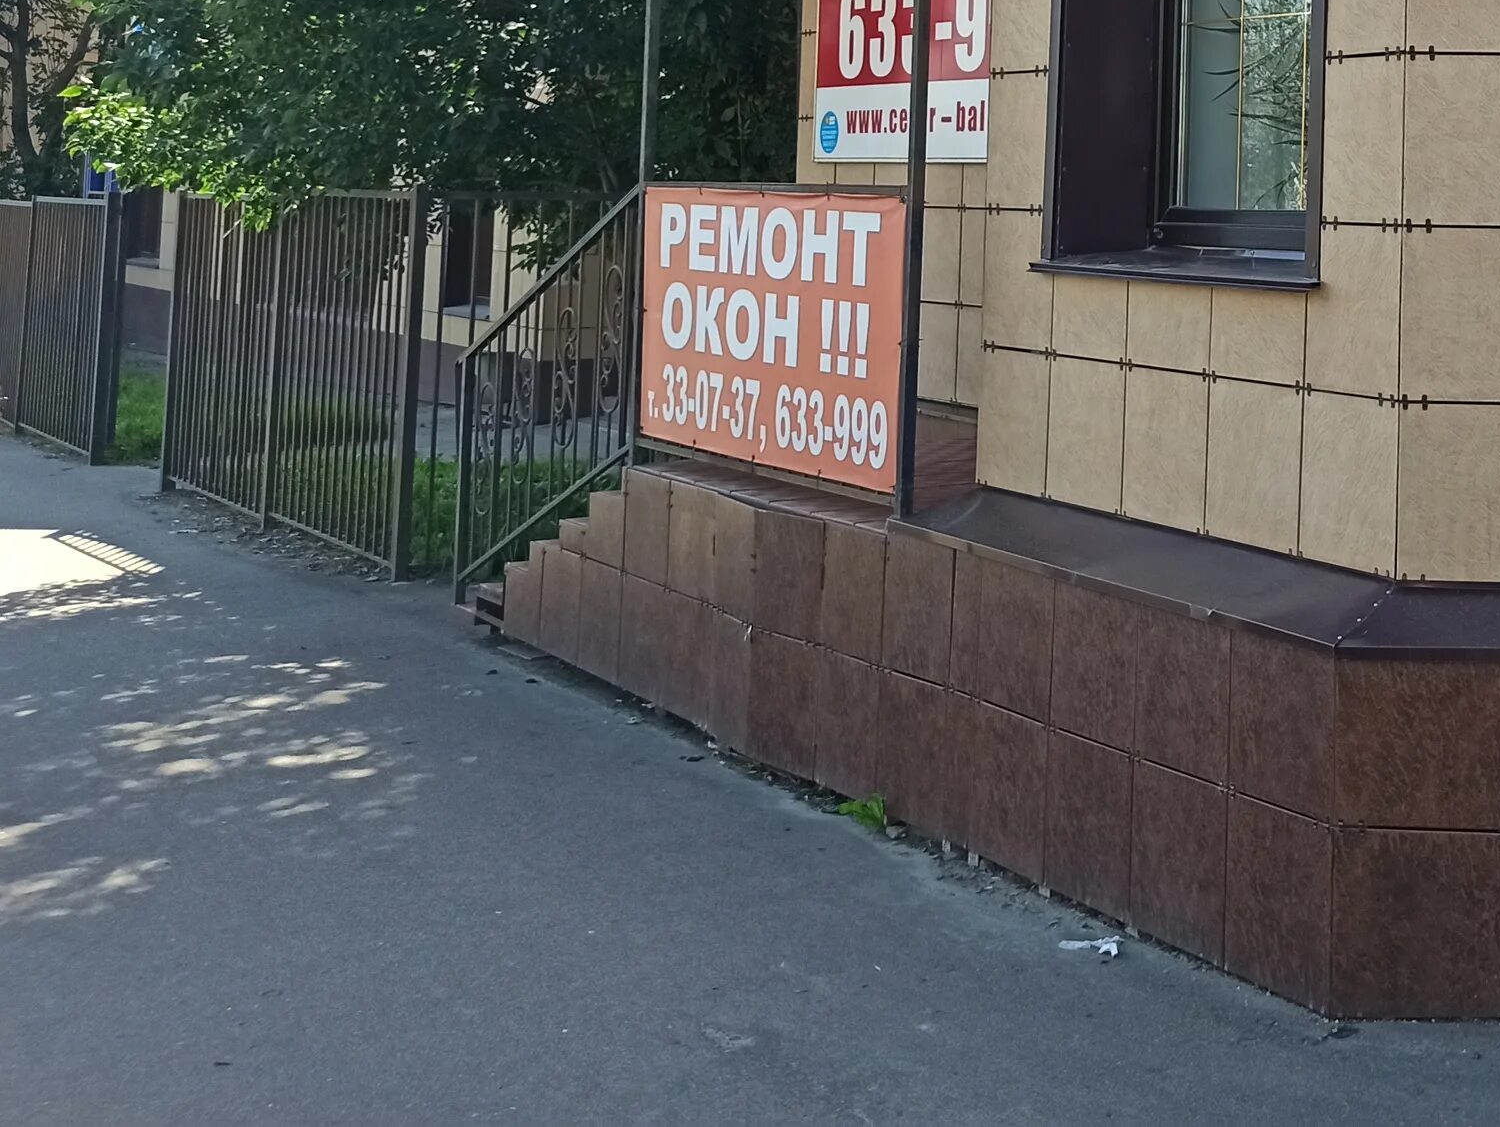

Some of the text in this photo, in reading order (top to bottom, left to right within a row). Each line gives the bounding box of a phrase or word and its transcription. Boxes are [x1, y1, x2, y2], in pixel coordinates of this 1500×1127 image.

[660, 202, 881, 287] РЕМОНТ
[661, 281, 870, 379] ОКОН !!!
[775, 384, 888, 470] 633-999
